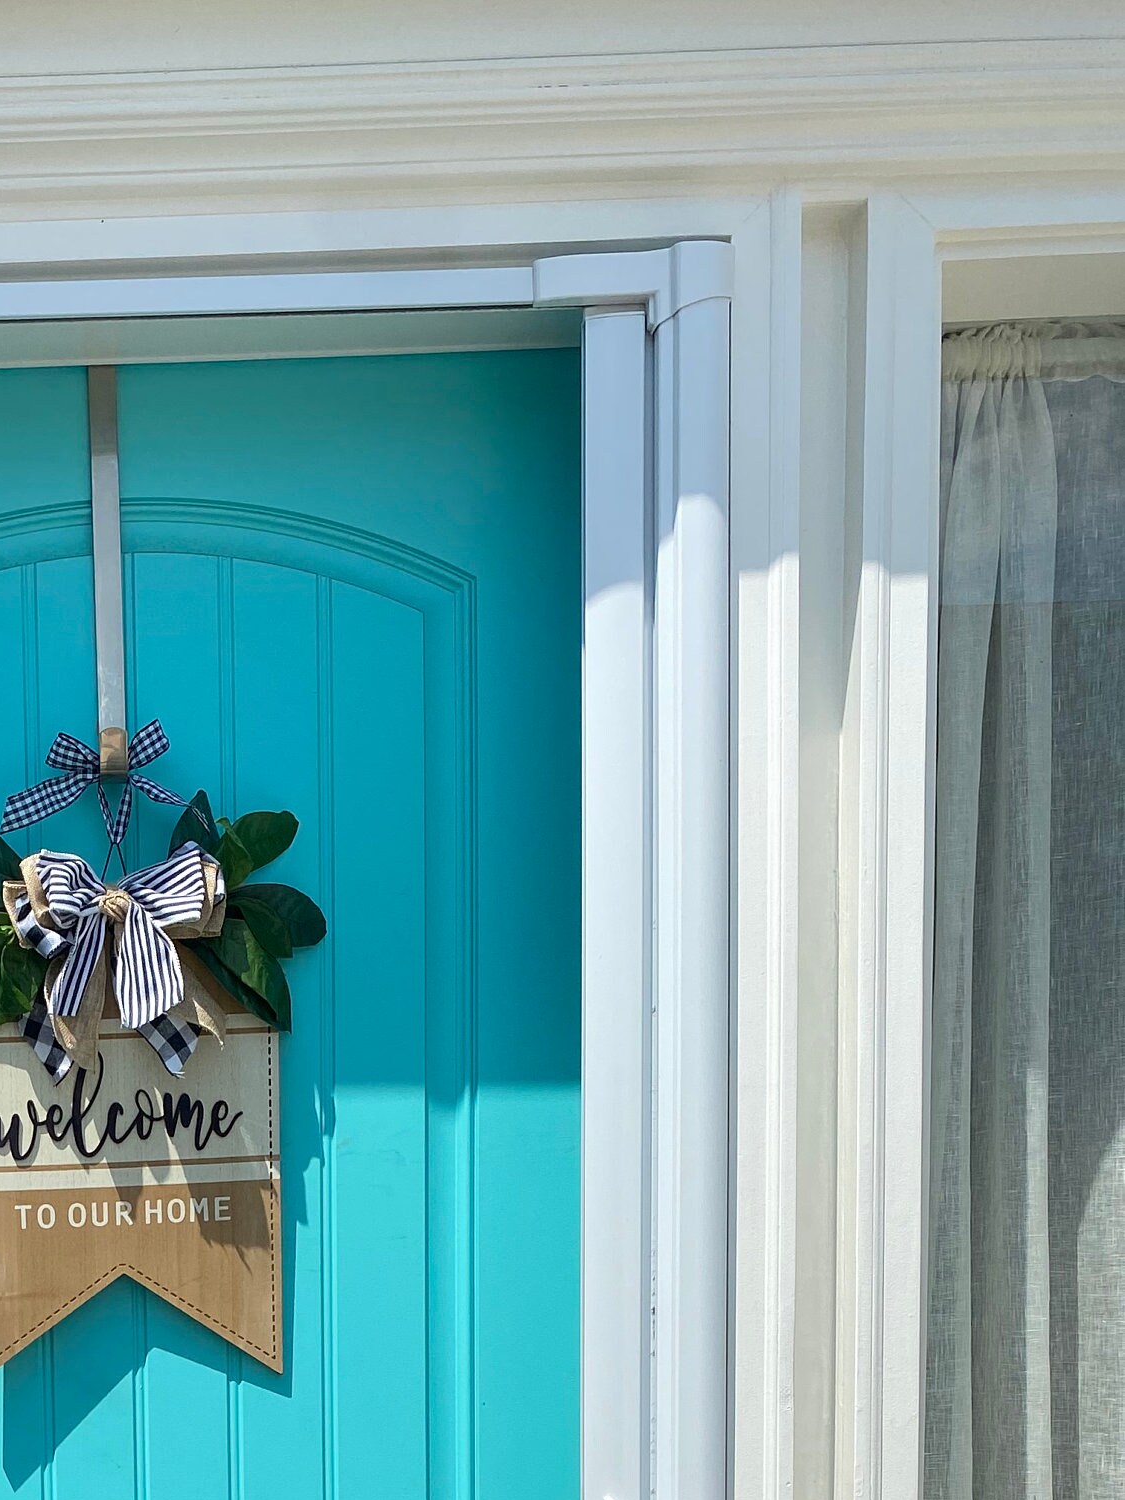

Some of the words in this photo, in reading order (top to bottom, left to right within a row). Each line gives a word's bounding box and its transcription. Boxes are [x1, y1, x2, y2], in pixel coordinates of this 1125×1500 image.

[14, 1204, 56, 1230] TO
[68, 1202, 133, 1228] OUR
[144, 1196, 231, 1225] HOME
